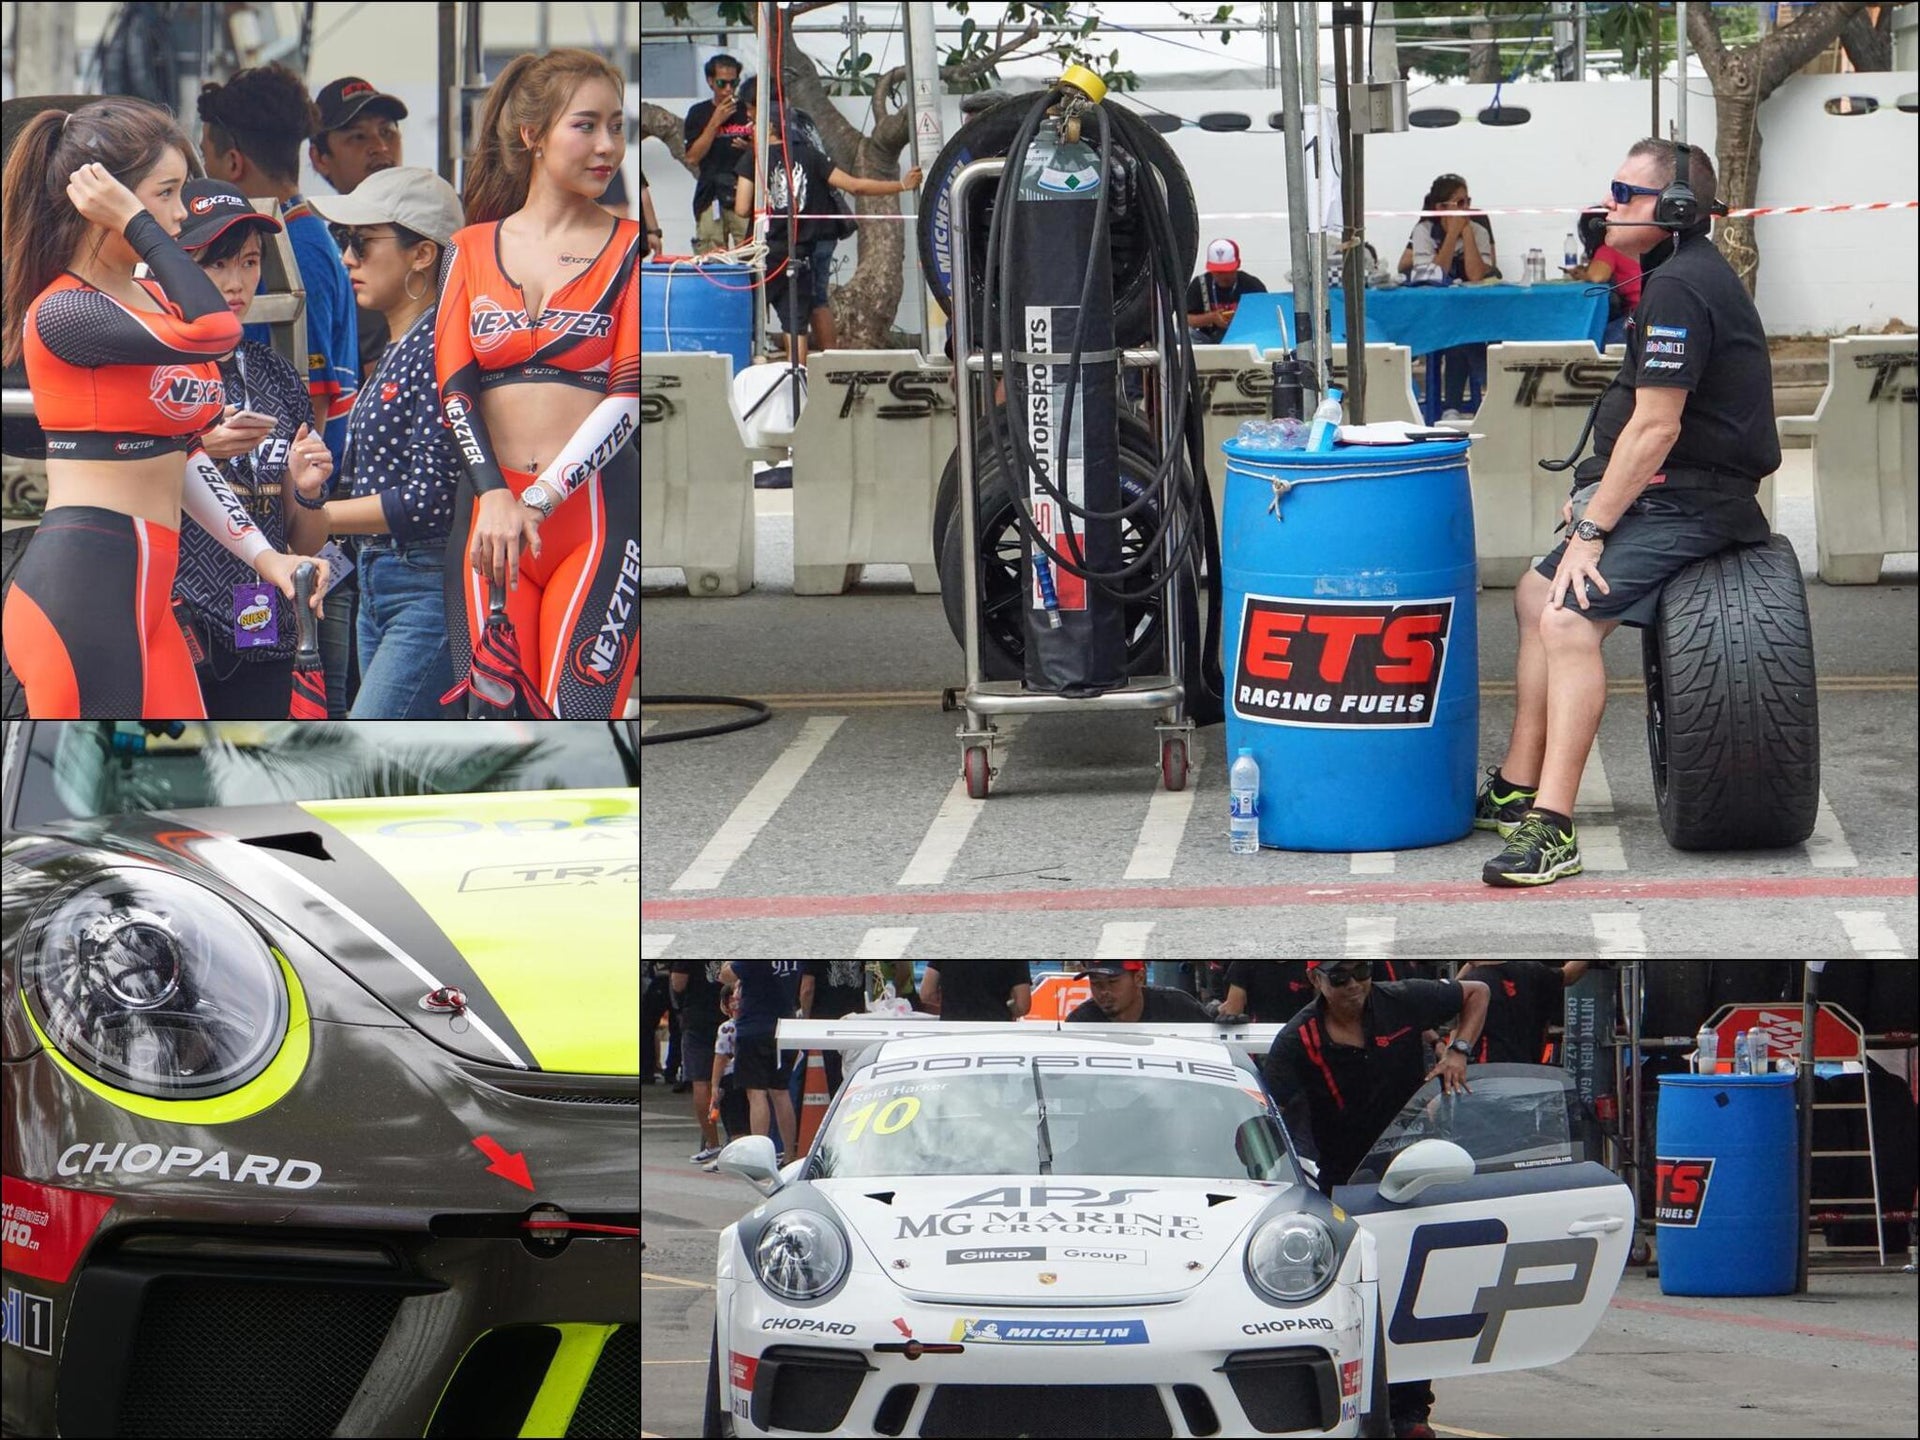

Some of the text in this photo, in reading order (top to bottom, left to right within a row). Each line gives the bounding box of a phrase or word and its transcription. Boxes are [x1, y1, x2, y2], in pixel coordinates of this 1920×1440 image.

[470, 308, 614, 338] NEXZTER
[442, 394, 485, 465] NEXZTER
[564, 412, 633, 492] NEXZTER
[197, 464, 257, 531] NEXZTER
[586, 539, 639, 684] NEXZTER
[1246, 610, 1442, 684] ETS
[1340, 694, 1426, 713] FUELS
[870, 1055, 1238, 1083] PORSCHE
[841, 1096, 921, 1142] 10
[57, 1142, 322, 1189] CHOPARD
[893, 1211, 1201, 1240] MG MARINE
[981, 1223, 1204, 1241] CRYOGENIC
[960, 1249, 1128, 1262] Giltrap Group
[761, 1317, 856, 1336] CHOPARD
[1005, 1327, 1131, 1338] MICHELIN
[1242, 1317, 1334, 1336] CHOPARD
